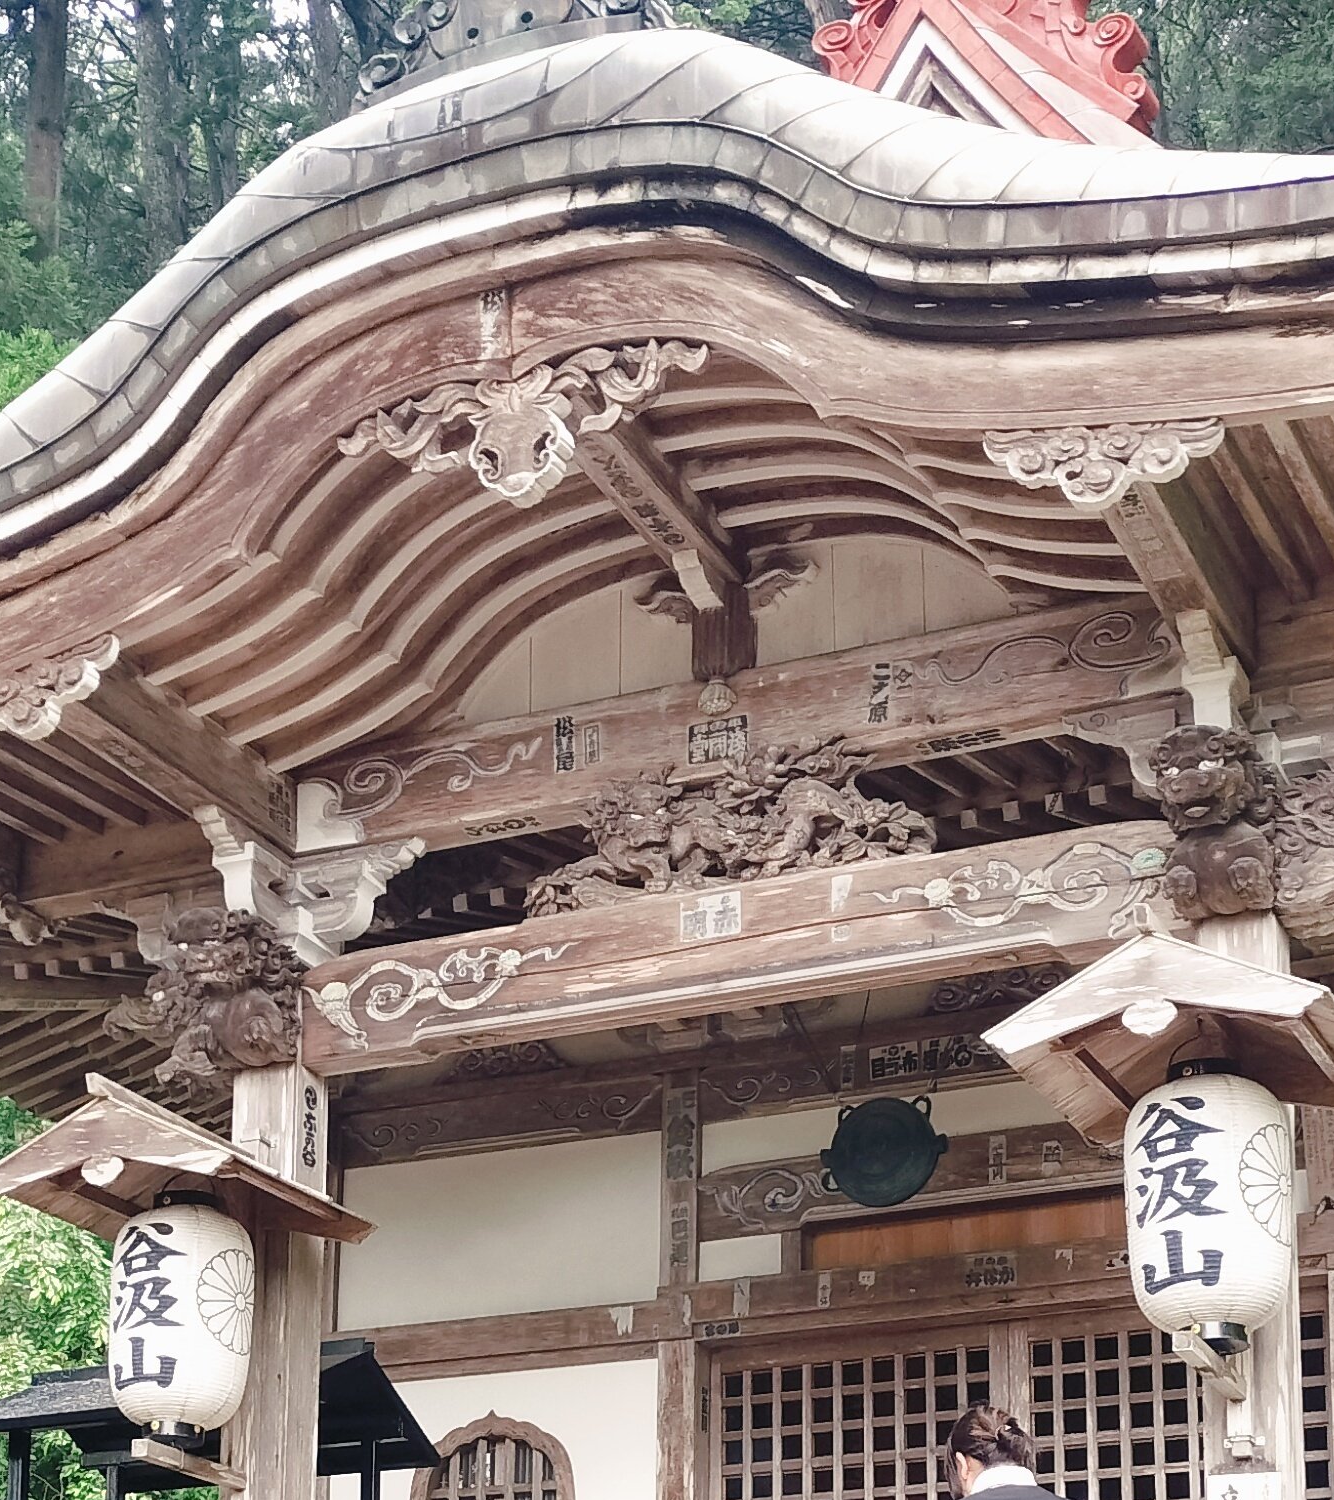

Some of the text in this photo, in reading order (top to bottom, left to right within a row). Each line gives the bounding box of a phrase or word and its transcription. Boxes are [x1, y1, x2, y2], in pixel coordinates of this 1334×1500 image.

[1131, 1096, 1229, 1296] 谷汲山
[112, 1222, 188, 1391] 谷汲山
